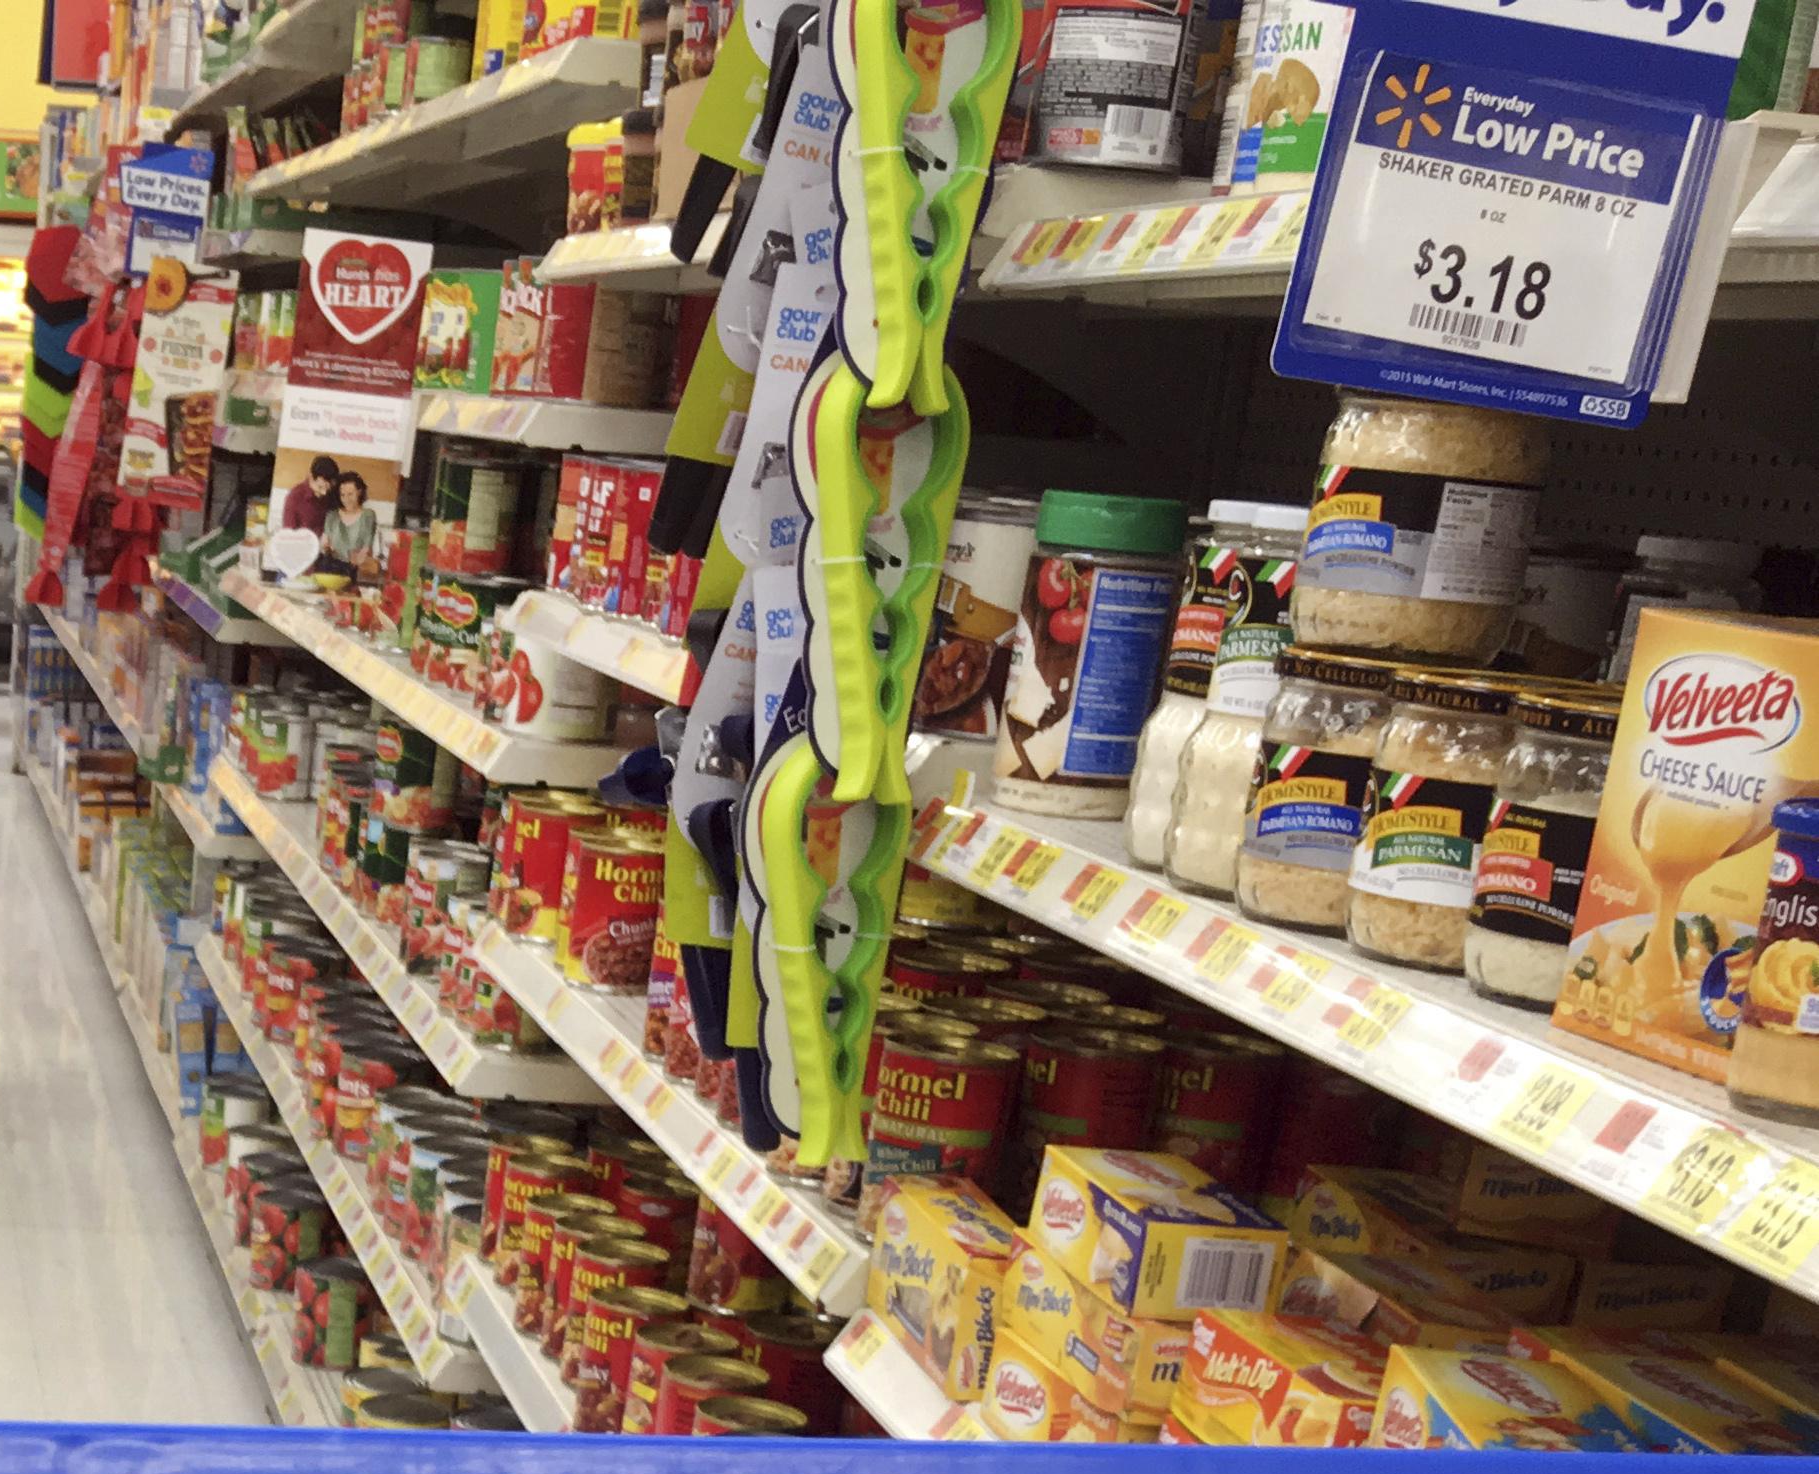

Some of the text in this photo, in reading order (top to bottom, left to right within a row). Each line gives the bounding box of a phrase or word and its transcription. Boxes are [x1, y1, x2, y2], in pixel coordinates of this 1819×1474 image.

[1463, 87, 1535, 117] Everyday
[793, 111, 831, 133] club
[783, 139, 820, 163] CAN
[1452, 104, 1645, 179] Low Price
[126, 170, 206, 197] Low Prices.
[1379, 151, 1638, 219] SHAKER GRATED PARM 8 OZ
[126, 186, 168, 207] Every
[1490, 211, 1507, 223] OZ
[1413, 239, 1552, 321] $3.18
[324, 281, 405, 308] HEART
[776, 321, 817, 344] club
[770, 354, 810, 373] CAN
[1415, 686, 1482, 711] NATURAL
[1648, 669, 1795, 733] Velveeta
[1377, 844, 1462, 863] PARMESAN
